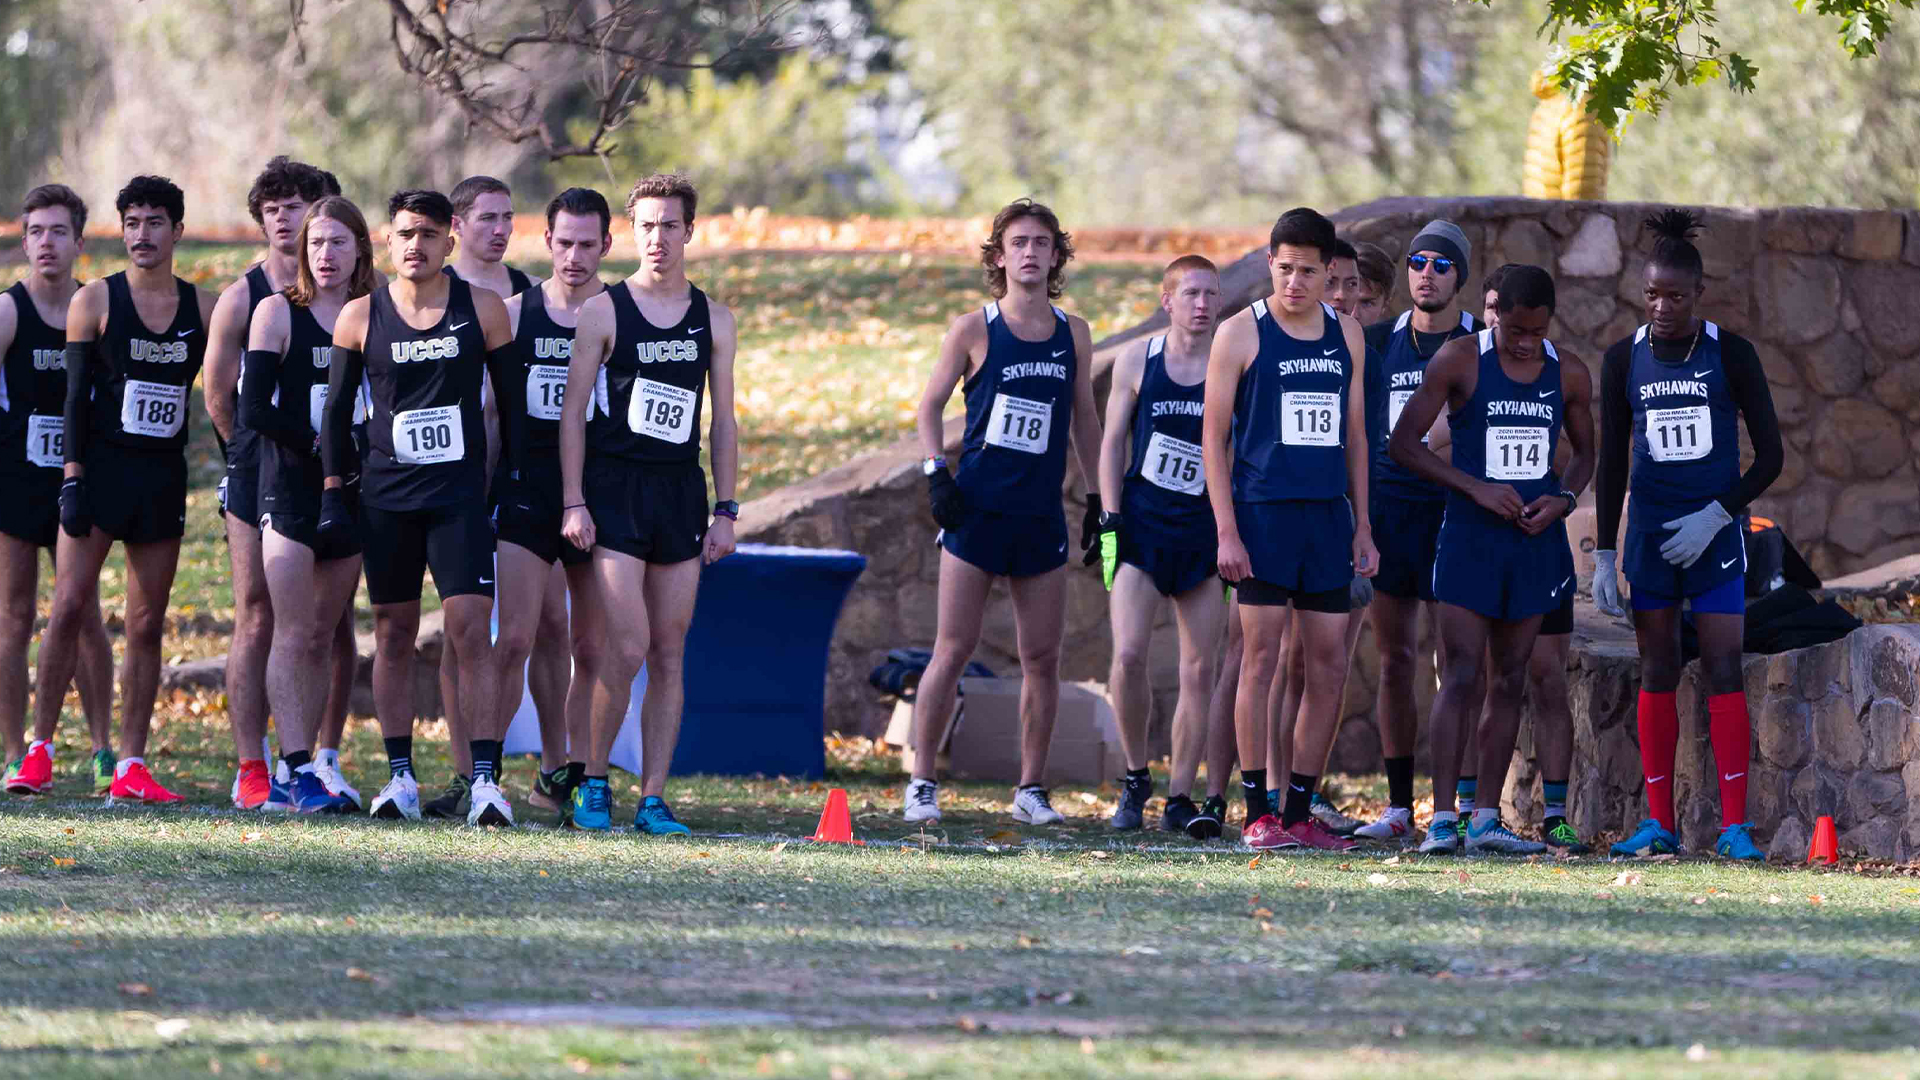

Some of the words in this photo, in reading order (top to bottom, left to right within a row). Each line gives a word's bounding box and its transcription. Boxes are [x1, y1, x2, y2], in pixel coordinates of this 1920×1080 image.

[33, 349, 67, 370] UC
[130, 338, 188, 363] UCCS
[391, 336, 459, 363] UCCS
[535, 338, 575, 358] UC
[637, 340, 698, 363] UCCS
[1002, 362, 1066, 382] SKYHAWKS
[1279, 358, 1342, 376] SKYHAWKS
[646, 382, 661, 390] 2020
[1391, 370, 1423, 388] SKYH
[1640, 380, 1708, 400] SKYHAWKS
[540, 382, 566, 407] 18
[643, 388, 689, 404] CHAMPIONSHIPS
[136, 398, 177, 425] 188
[401, 414, 452, 426] CHAMPIONSHIPS
[644, 398, 684, 429] 193
[1151, 400, 1205, 417] SKYHAW
[1487, 401, 1553, 420] SKYHAWKS
[1654, 414, 1701, 422] CHAMPIONSHIPS
[1003, 412, 1042, 441] 118
[1294, 409, 1331, 433] 113
[40, 433, 63, 456] 19
[407, 423, 451, 452] 190
[1658, 423, 1697, 449] 111
[1500, 443, 1539, 467] 114
[1158, 452, 1199, 482] 115
